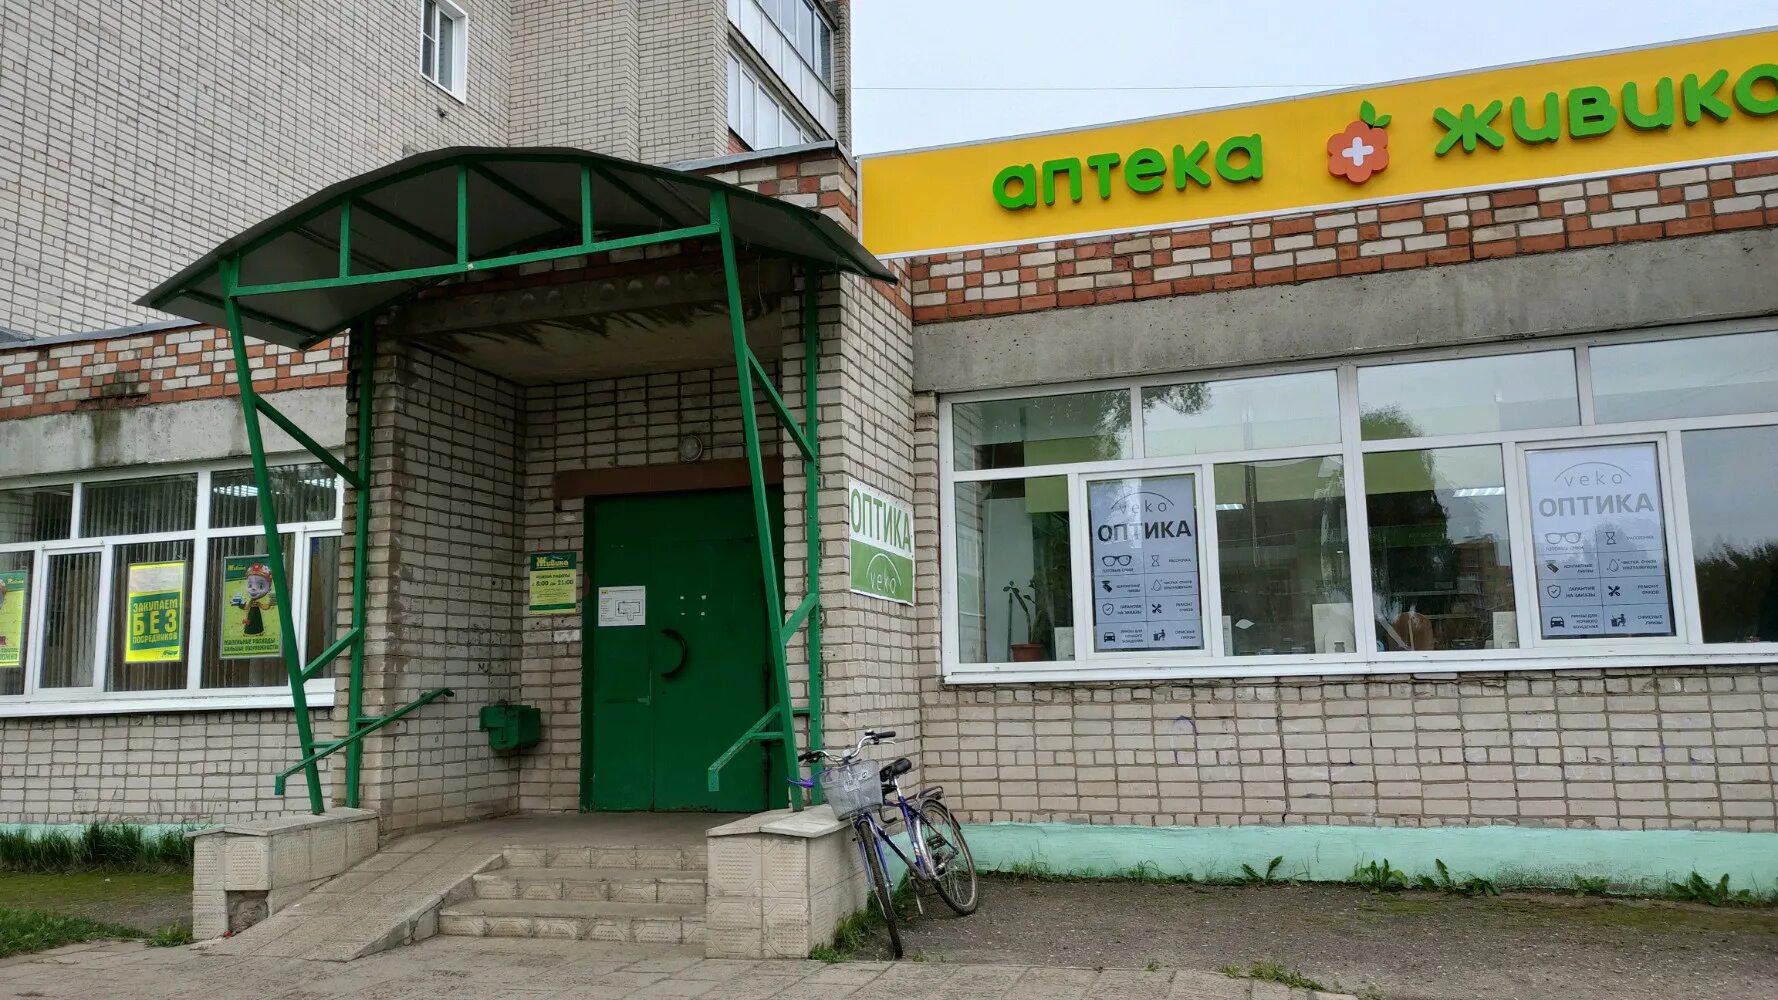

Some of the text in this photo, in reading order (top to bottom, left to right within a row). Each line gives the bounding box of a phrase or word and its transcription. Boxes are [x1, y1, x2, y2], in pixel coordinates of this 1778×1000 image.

[993, 133, 1263, 211] аптека
[1563, 470, 1623, 487] veko
[1118, 499, 1168, 515] veko
[1538, 493, 1655, 518] ОПТИКА
[850, 488, 912, 553] ОПТИКА
[1097, 519, 1192, 542] ОПТИКА
[870, 569, 897, 594] veko
[133, 598, 178, 612] ЗАКУПАЕМ
[133, 608, 177, 636] БЕЗ
[132, 632, 178, 644] ПОСРЕДНИКОВ
